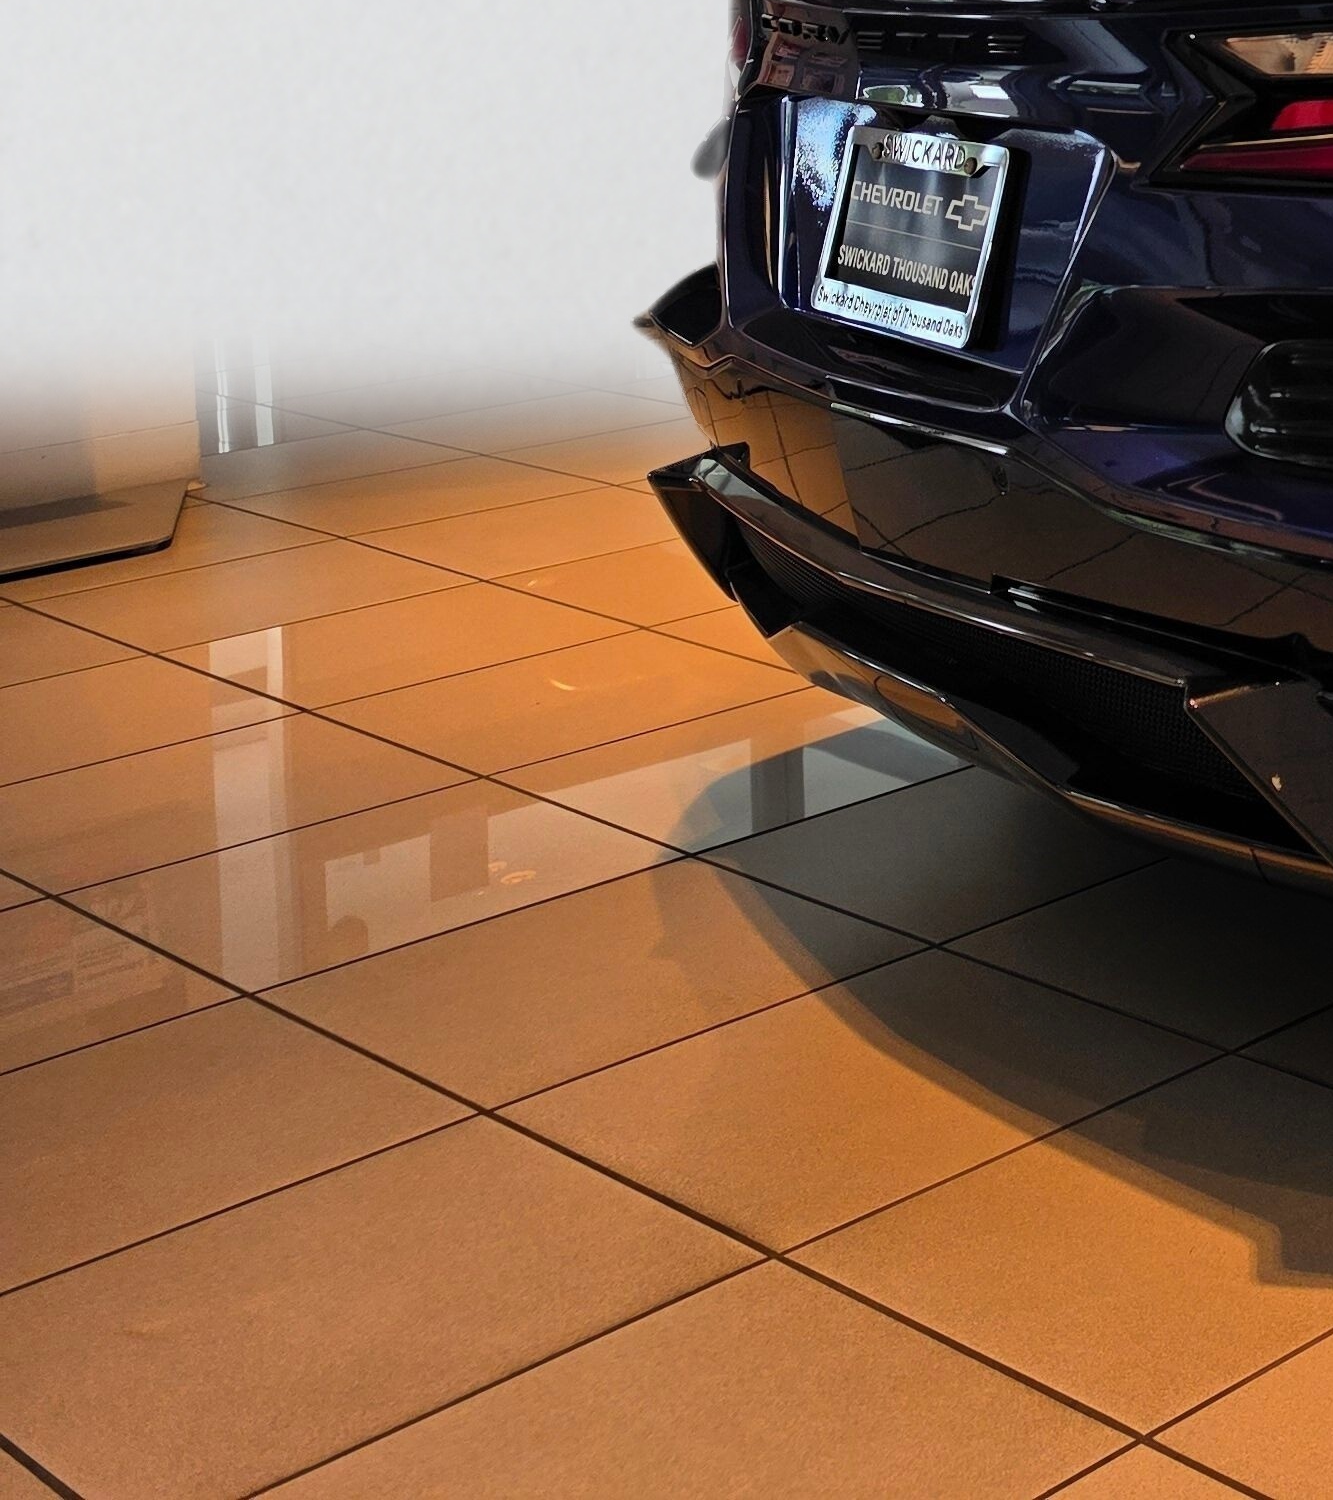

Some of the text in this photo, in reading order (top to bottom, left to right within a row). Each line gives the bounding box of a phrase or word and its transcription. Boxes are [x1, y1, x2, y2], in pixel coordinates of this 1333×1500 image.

[882, 134, 966, 171] SWICKARD
[851, 180, 944, 216] CHEVROLET
[837, 244, 891, 276] SWICKARD
[892, 256, 948, 291] THOUSAND
[817, 286, 855, 311] Swickard
[903, 304, 944, 334] Thousand
